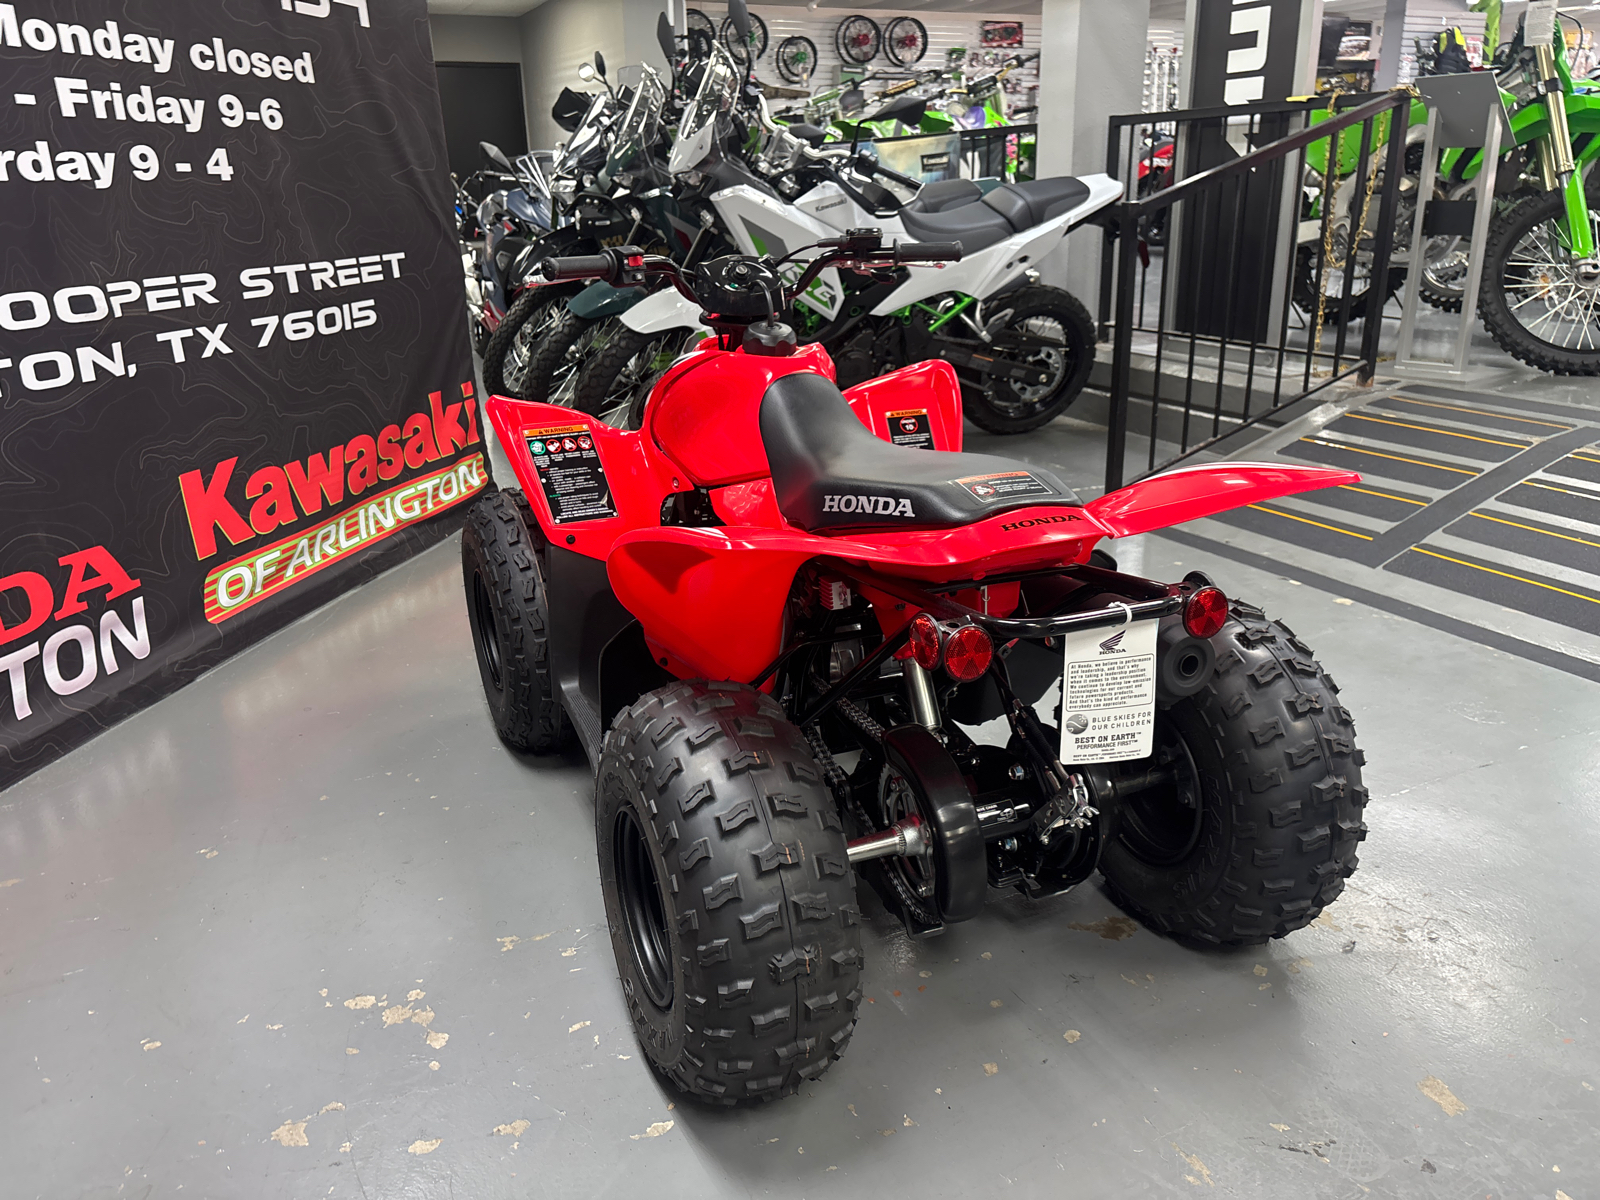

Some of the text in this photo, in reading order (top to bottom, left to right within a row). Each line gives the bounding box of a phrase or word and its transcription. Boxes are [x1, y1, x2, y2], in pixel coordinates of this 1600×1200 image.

[189, 38, 315, 84] closed
[14, 76, 284, 132] - Friday 9-6
[129, 144, 160, 181] 9
[175, 162, 193, 173] -
[205, 147, 234, 181] 4
[0, 252, 406, 332] OOPER STREET
[0, 299, 377, 398] ON, TX 76015
[544, 426, 574, 435] WARNING
[178, 381, 480, 561] Kawasaki
[822, 495, 915, 518] HONDA
[1001, 514, 1084, 532] HONDA
[216, 461, 483, 608] OF ARLINGTON
[0, 596, 150, 721] TON
[1111, 719, 1151, 728] CHILDREN
